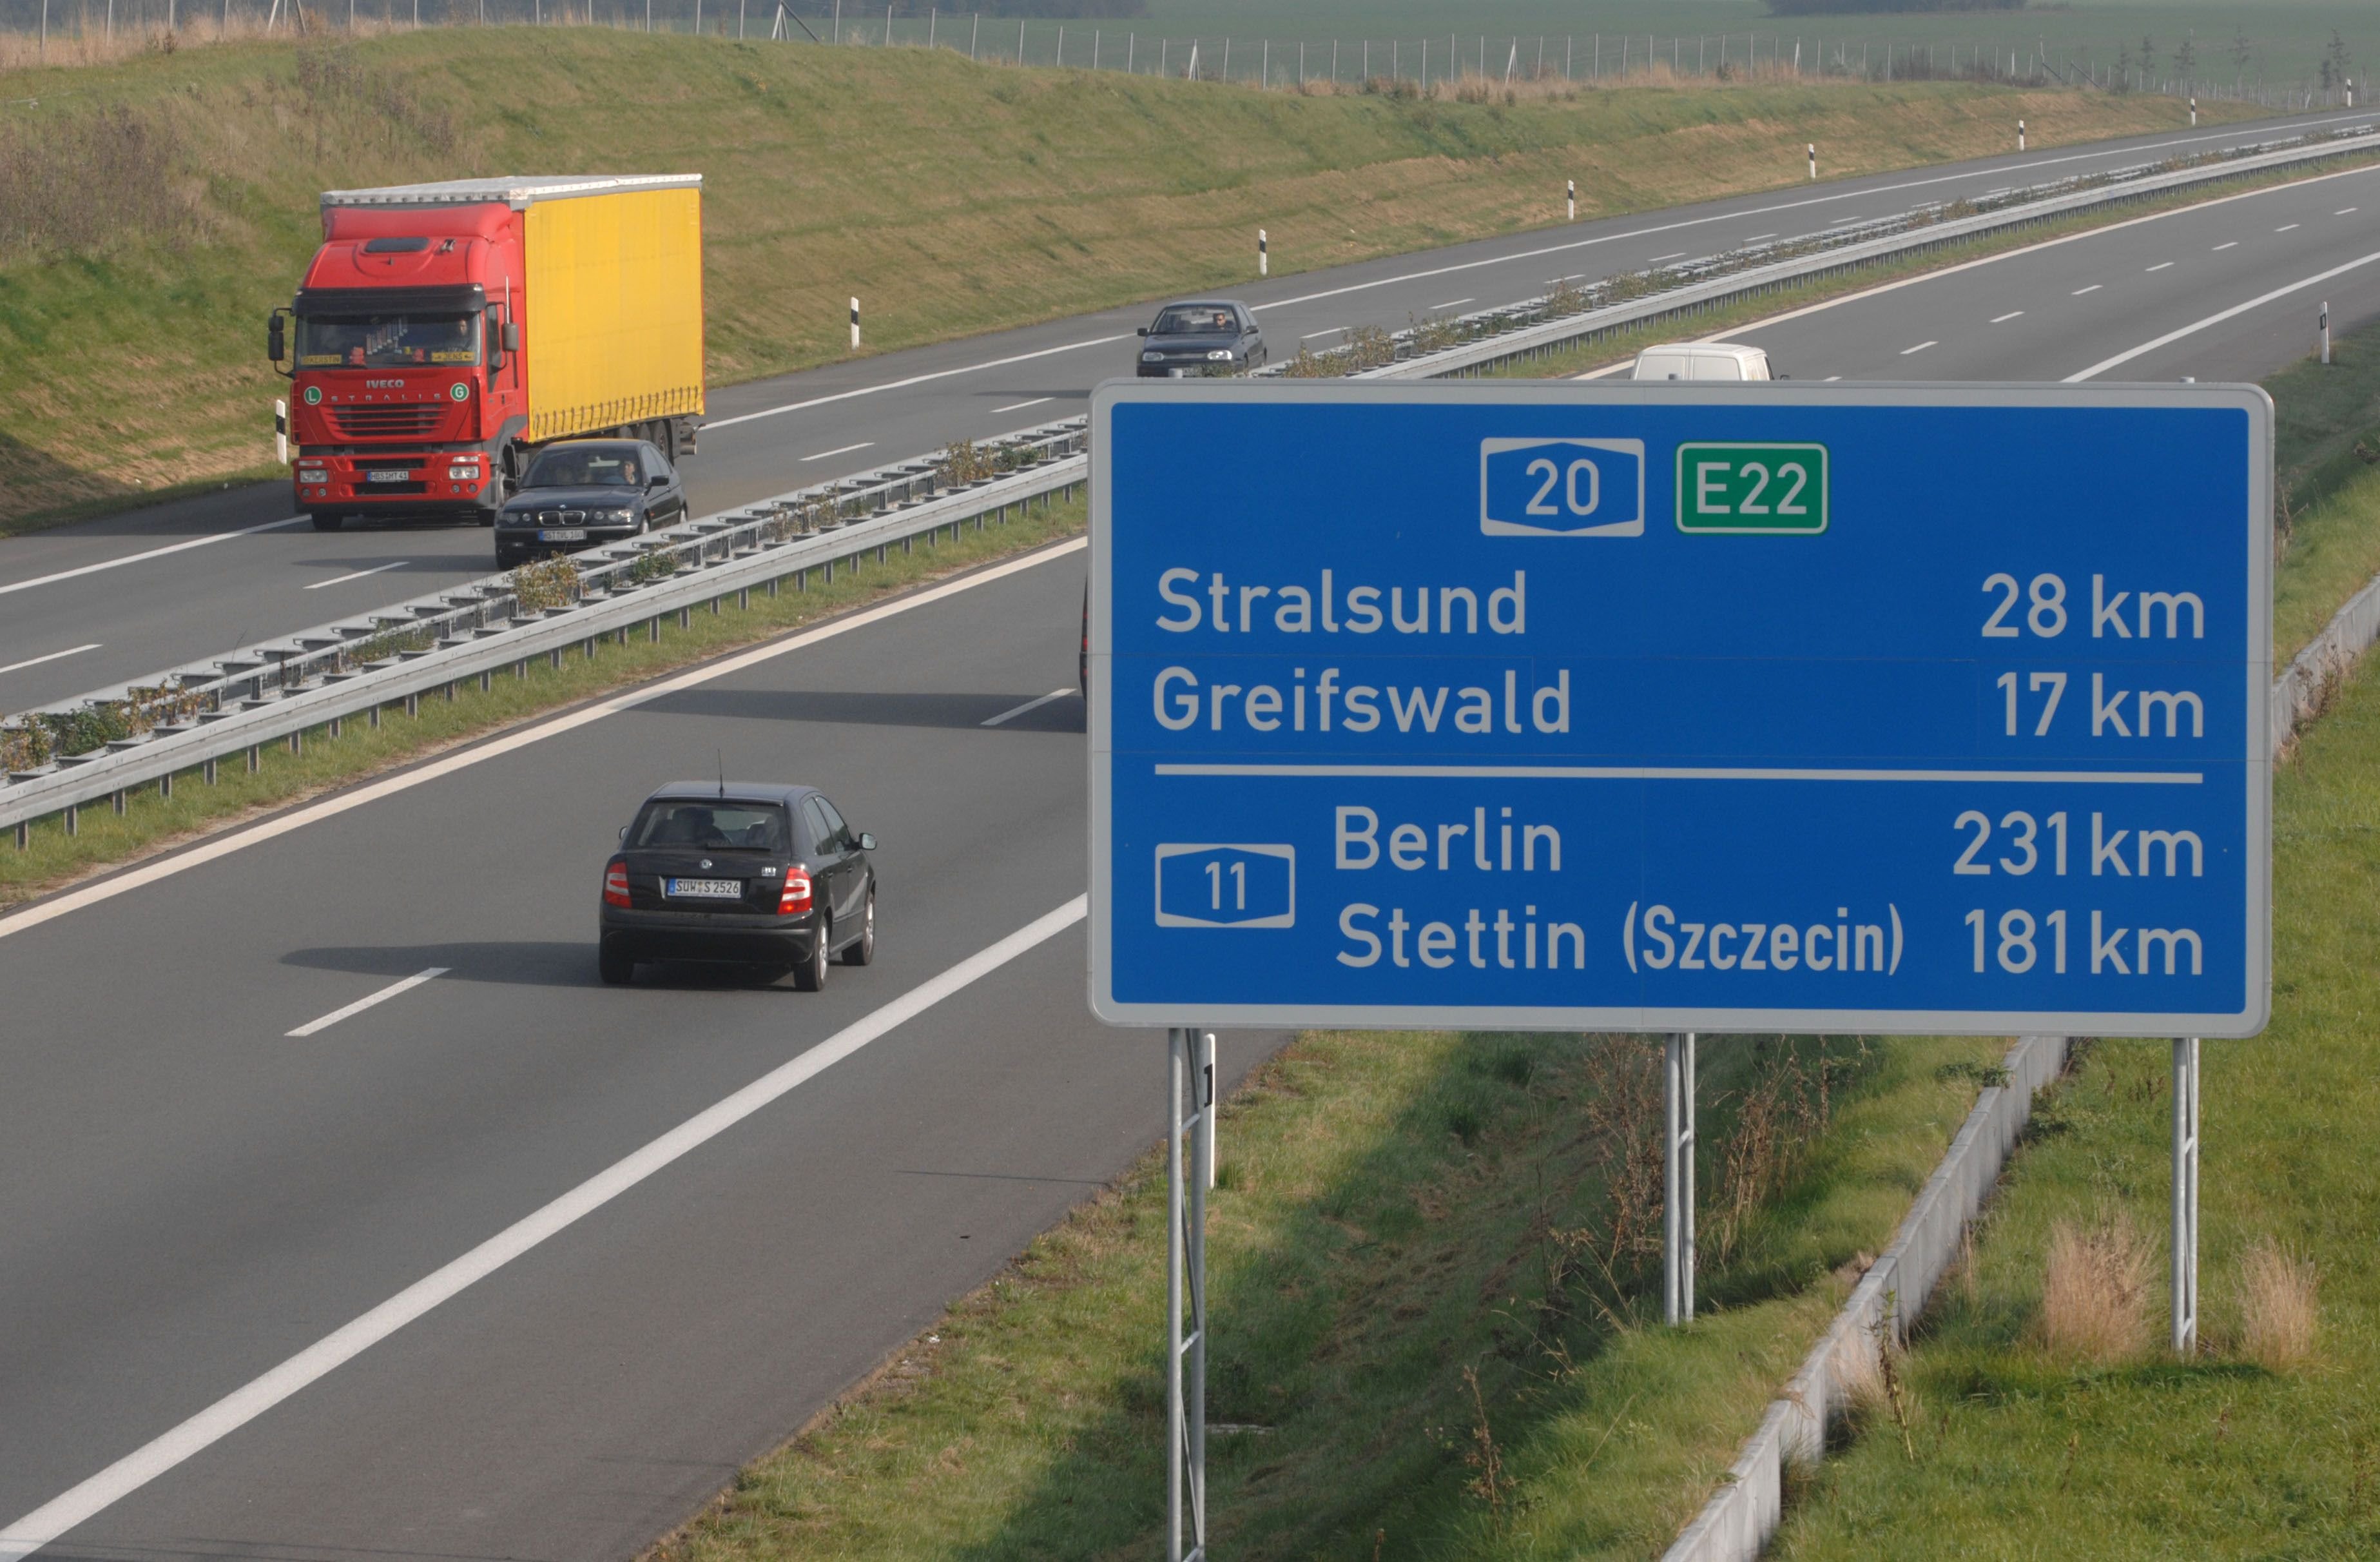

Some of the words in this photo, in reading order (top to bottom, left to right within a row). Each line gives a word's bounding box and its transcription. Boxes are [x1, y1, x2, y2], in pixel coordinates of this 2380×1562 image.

[309, 390, 316, 402] L
[331, 393, 441, 402] STRALIS
[366, 379, 404, 389] IVECO
[455, 387, 464, 398] G
[1526, 459, 1598, 516] 20
[1697, 462, 1806, 514] E22
[1156, 568, 1525, 634] Stralsund
[1982, 573, 2067, 638] 28
[2093, 574, 2204, 638] km
[1154, 667, 1569, 733] Greifswald
[1998, 672, 2067, 736] 17
[2092, 673, 2203, 737] km
[1335, 806, 1560, 871] Berlin
[1954, 811, 2067, 875] 231
[2092, 812, 2203, 877] km
[676, 879, 697, 892] SÜW
[713, 882, 739, 893] 2526
[1205, 861, 1245, 910] 11
[1337, 904, 1585, 969] Stettin
[1623, 901, 1903, 974] (Szczecin)
[1966, 910, 2066, 973] 181
[2091, 910, 2202, 975] km
